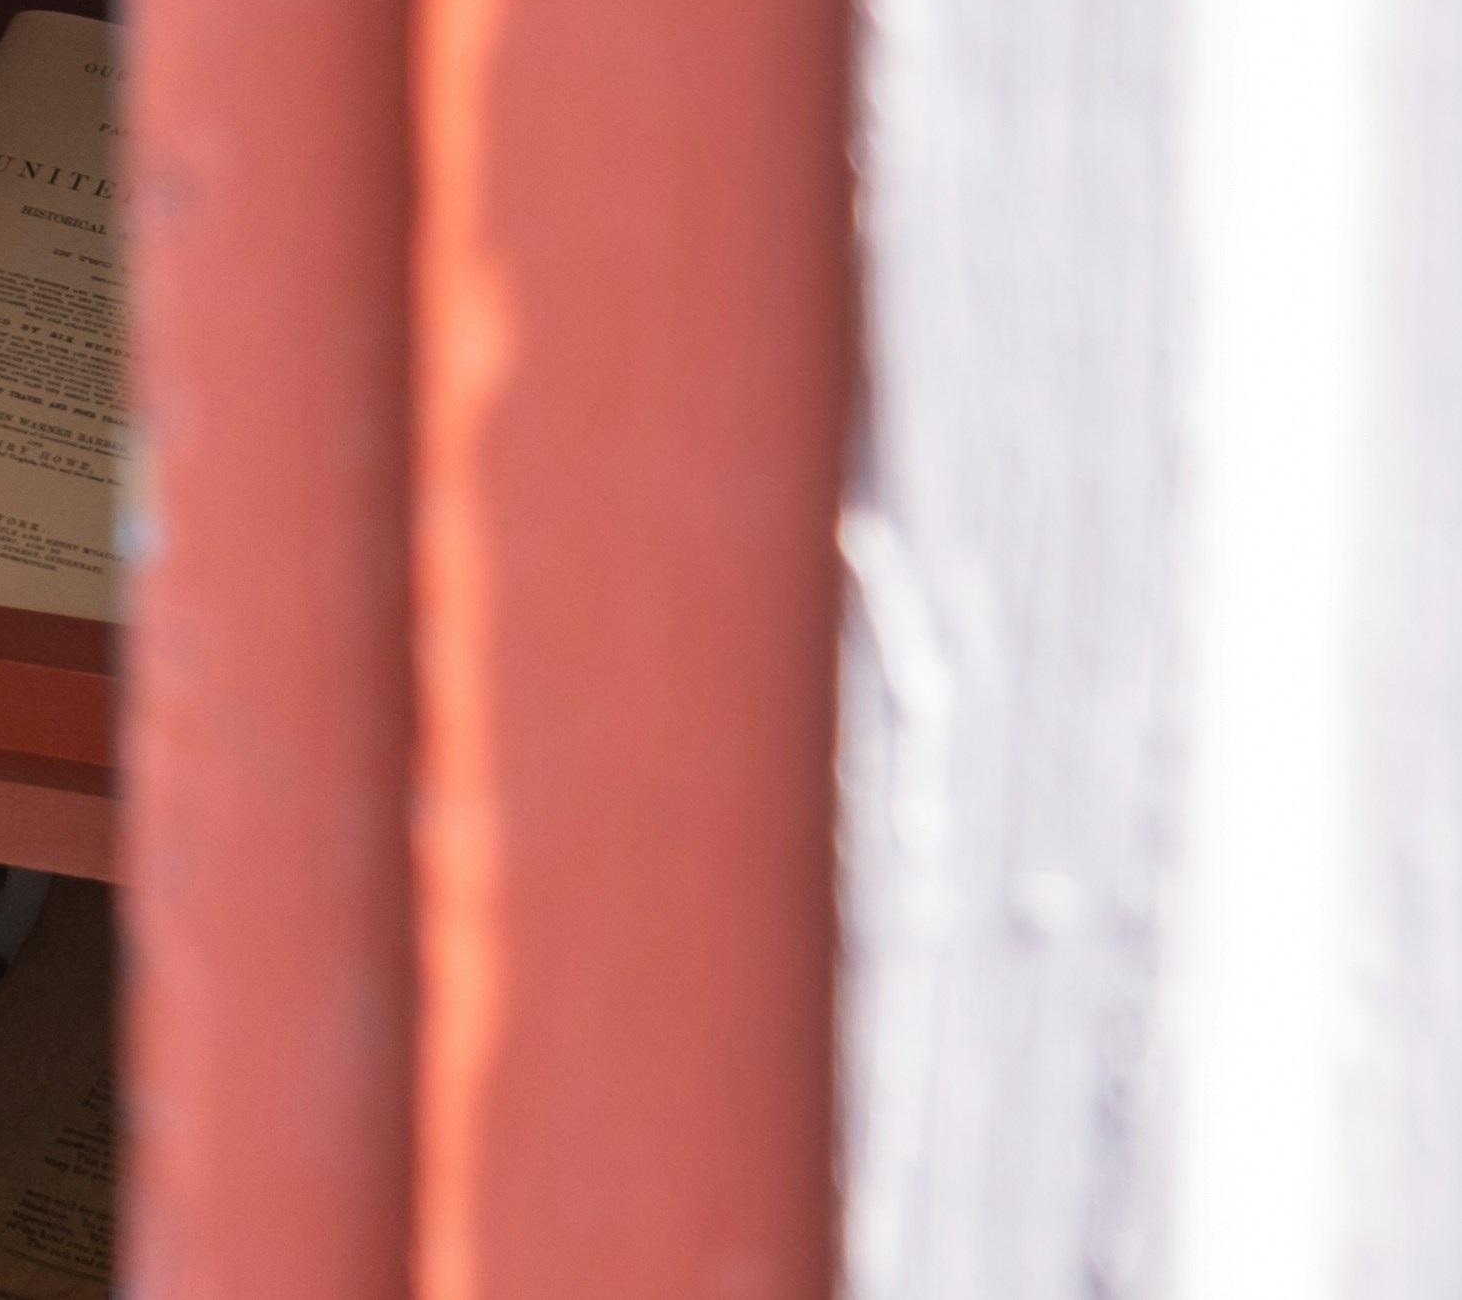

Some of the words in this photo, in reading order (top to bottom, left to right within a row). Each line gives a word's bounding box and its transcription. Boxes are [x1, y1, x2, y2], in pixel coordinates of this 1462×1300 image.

[20, 205, 107, 235] HISTORICAL
[19, 416, 73, 439] WARNER
[39, 450, 94, 475] HOWE,
